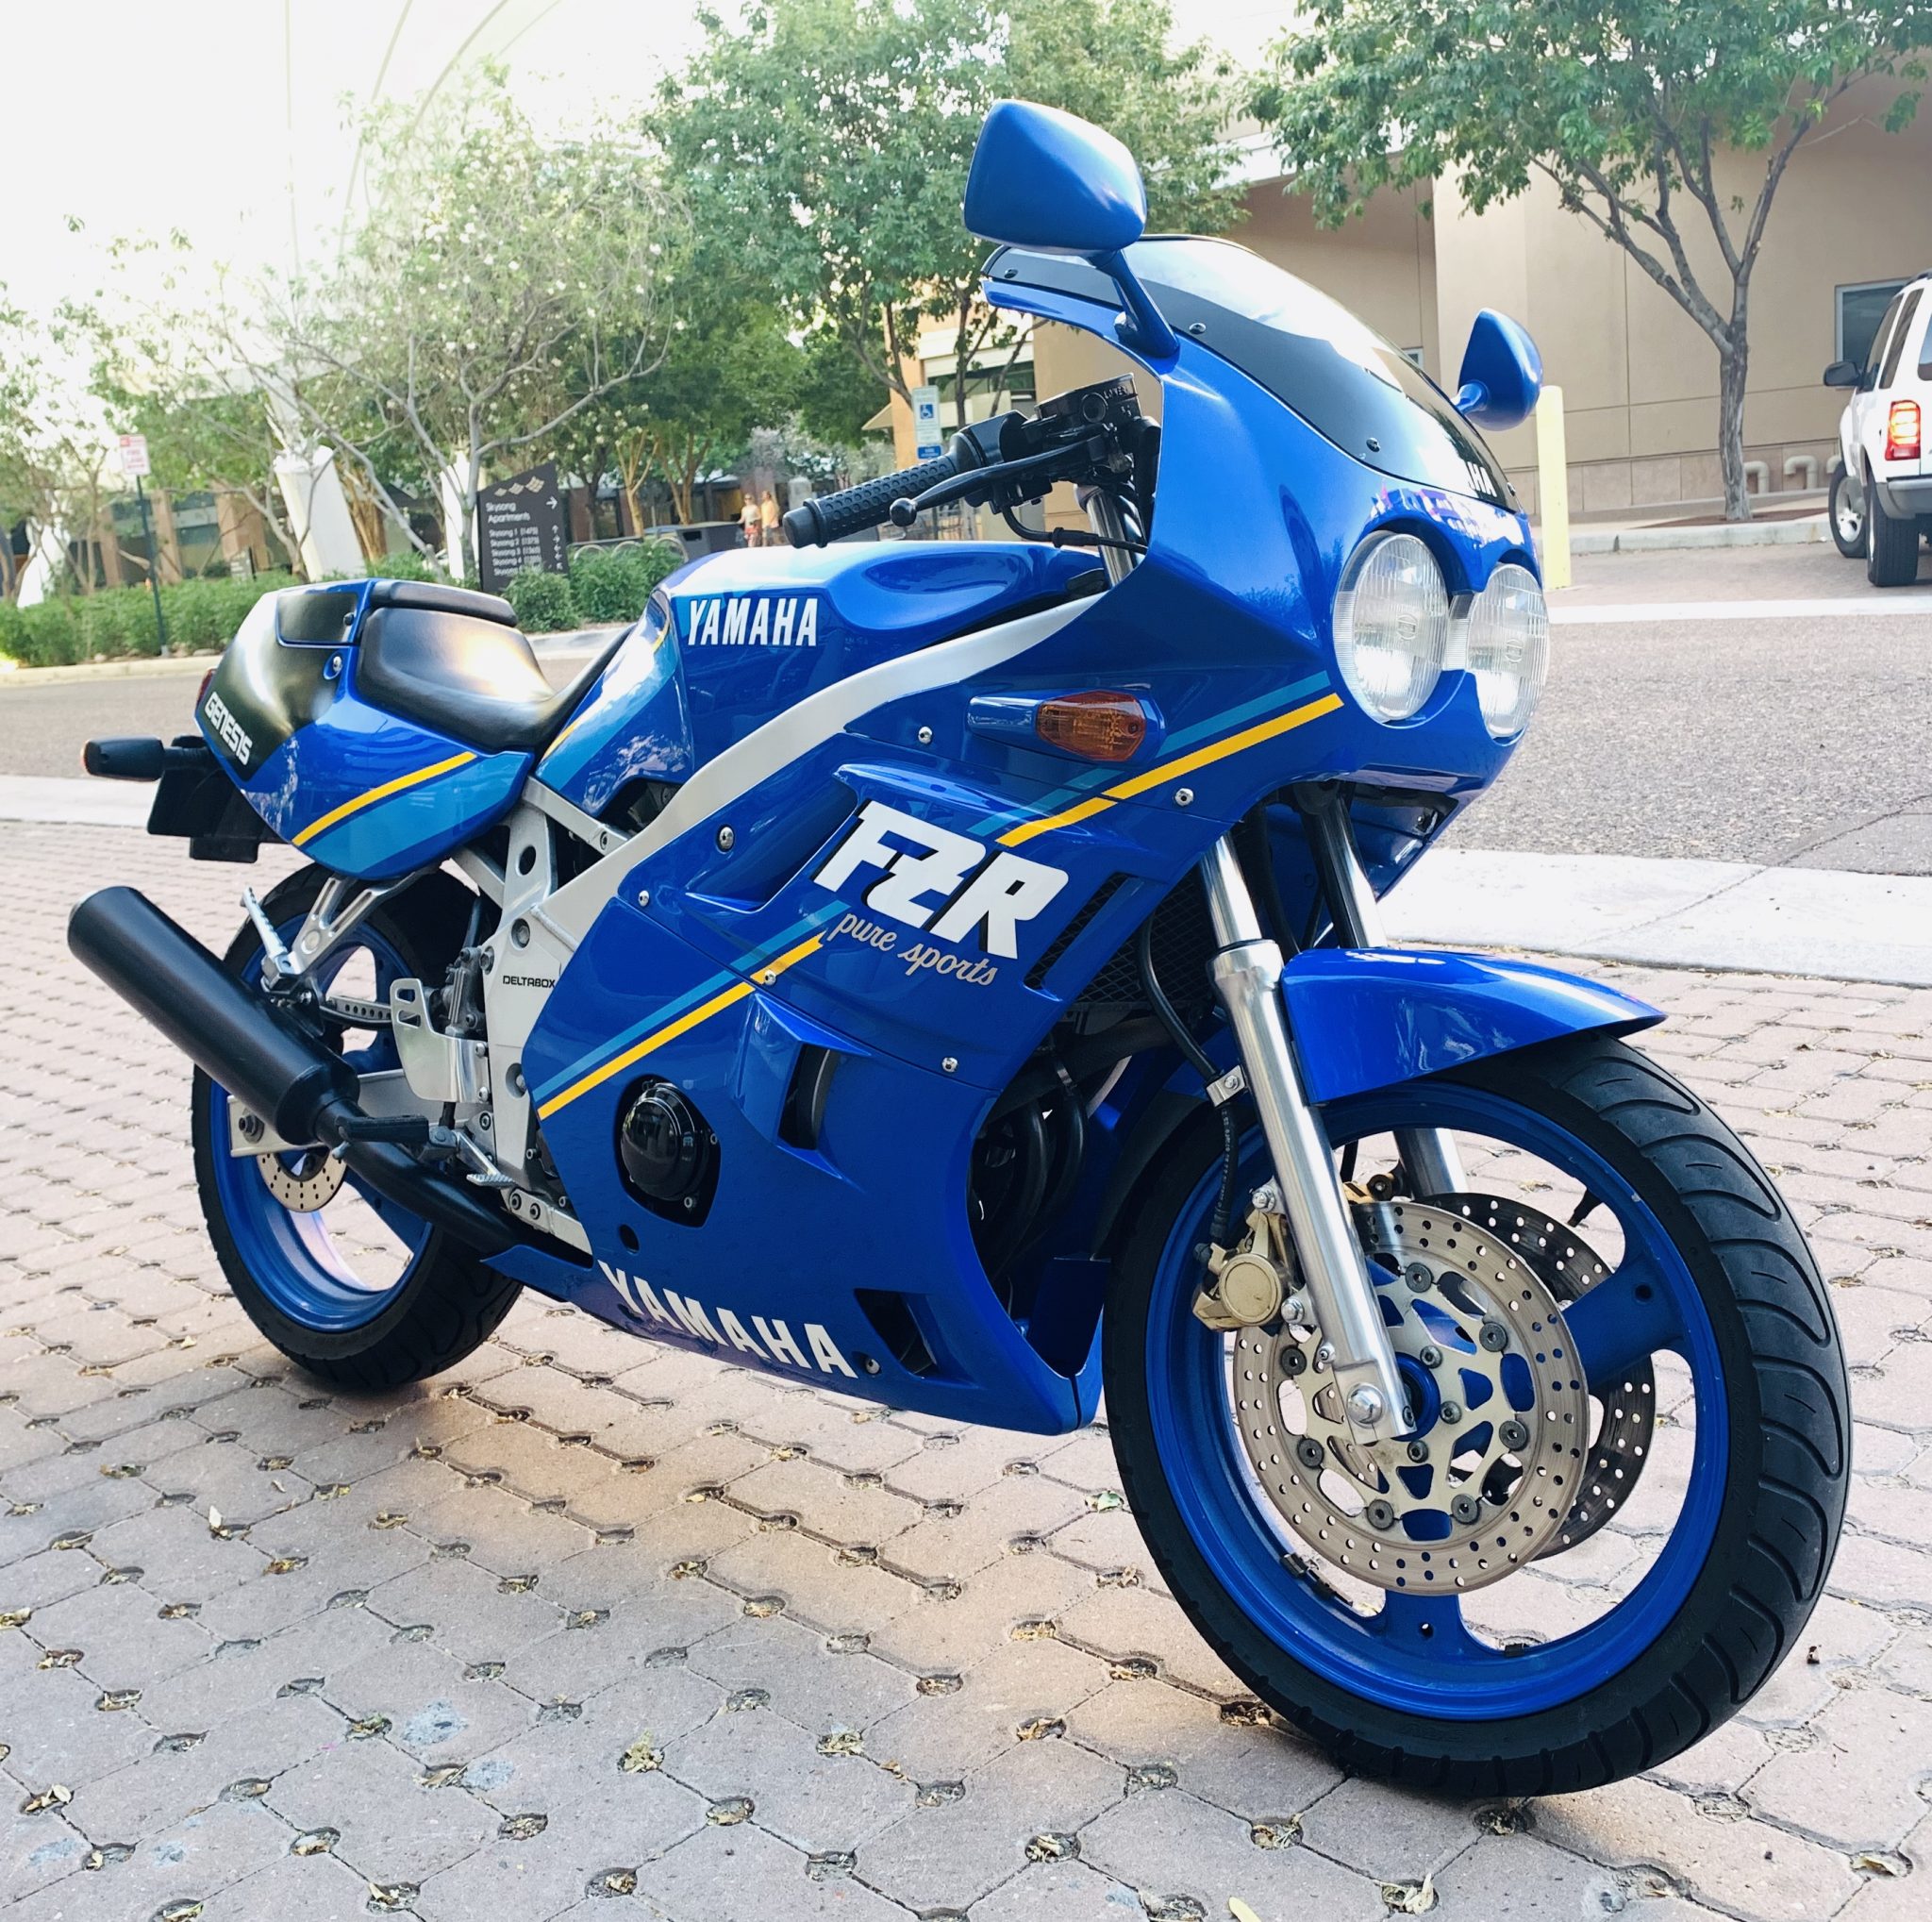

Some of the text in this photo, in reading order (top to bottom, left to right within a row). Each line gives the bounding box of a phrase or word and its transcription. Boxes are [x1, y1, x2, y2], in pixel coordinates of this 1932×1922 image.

[488, 512, 530, 524] Apartments
[688, 597, 818, 646] YAMAHA
[205, 692, 253, 765] GENESIS
[810, 799, 1069, 960] FZR
[503, 976, 556, 988] DELTABOX
[826, 912, 998, 986] pure sports
[597, 1259, 858, 1379] YAMAHA
